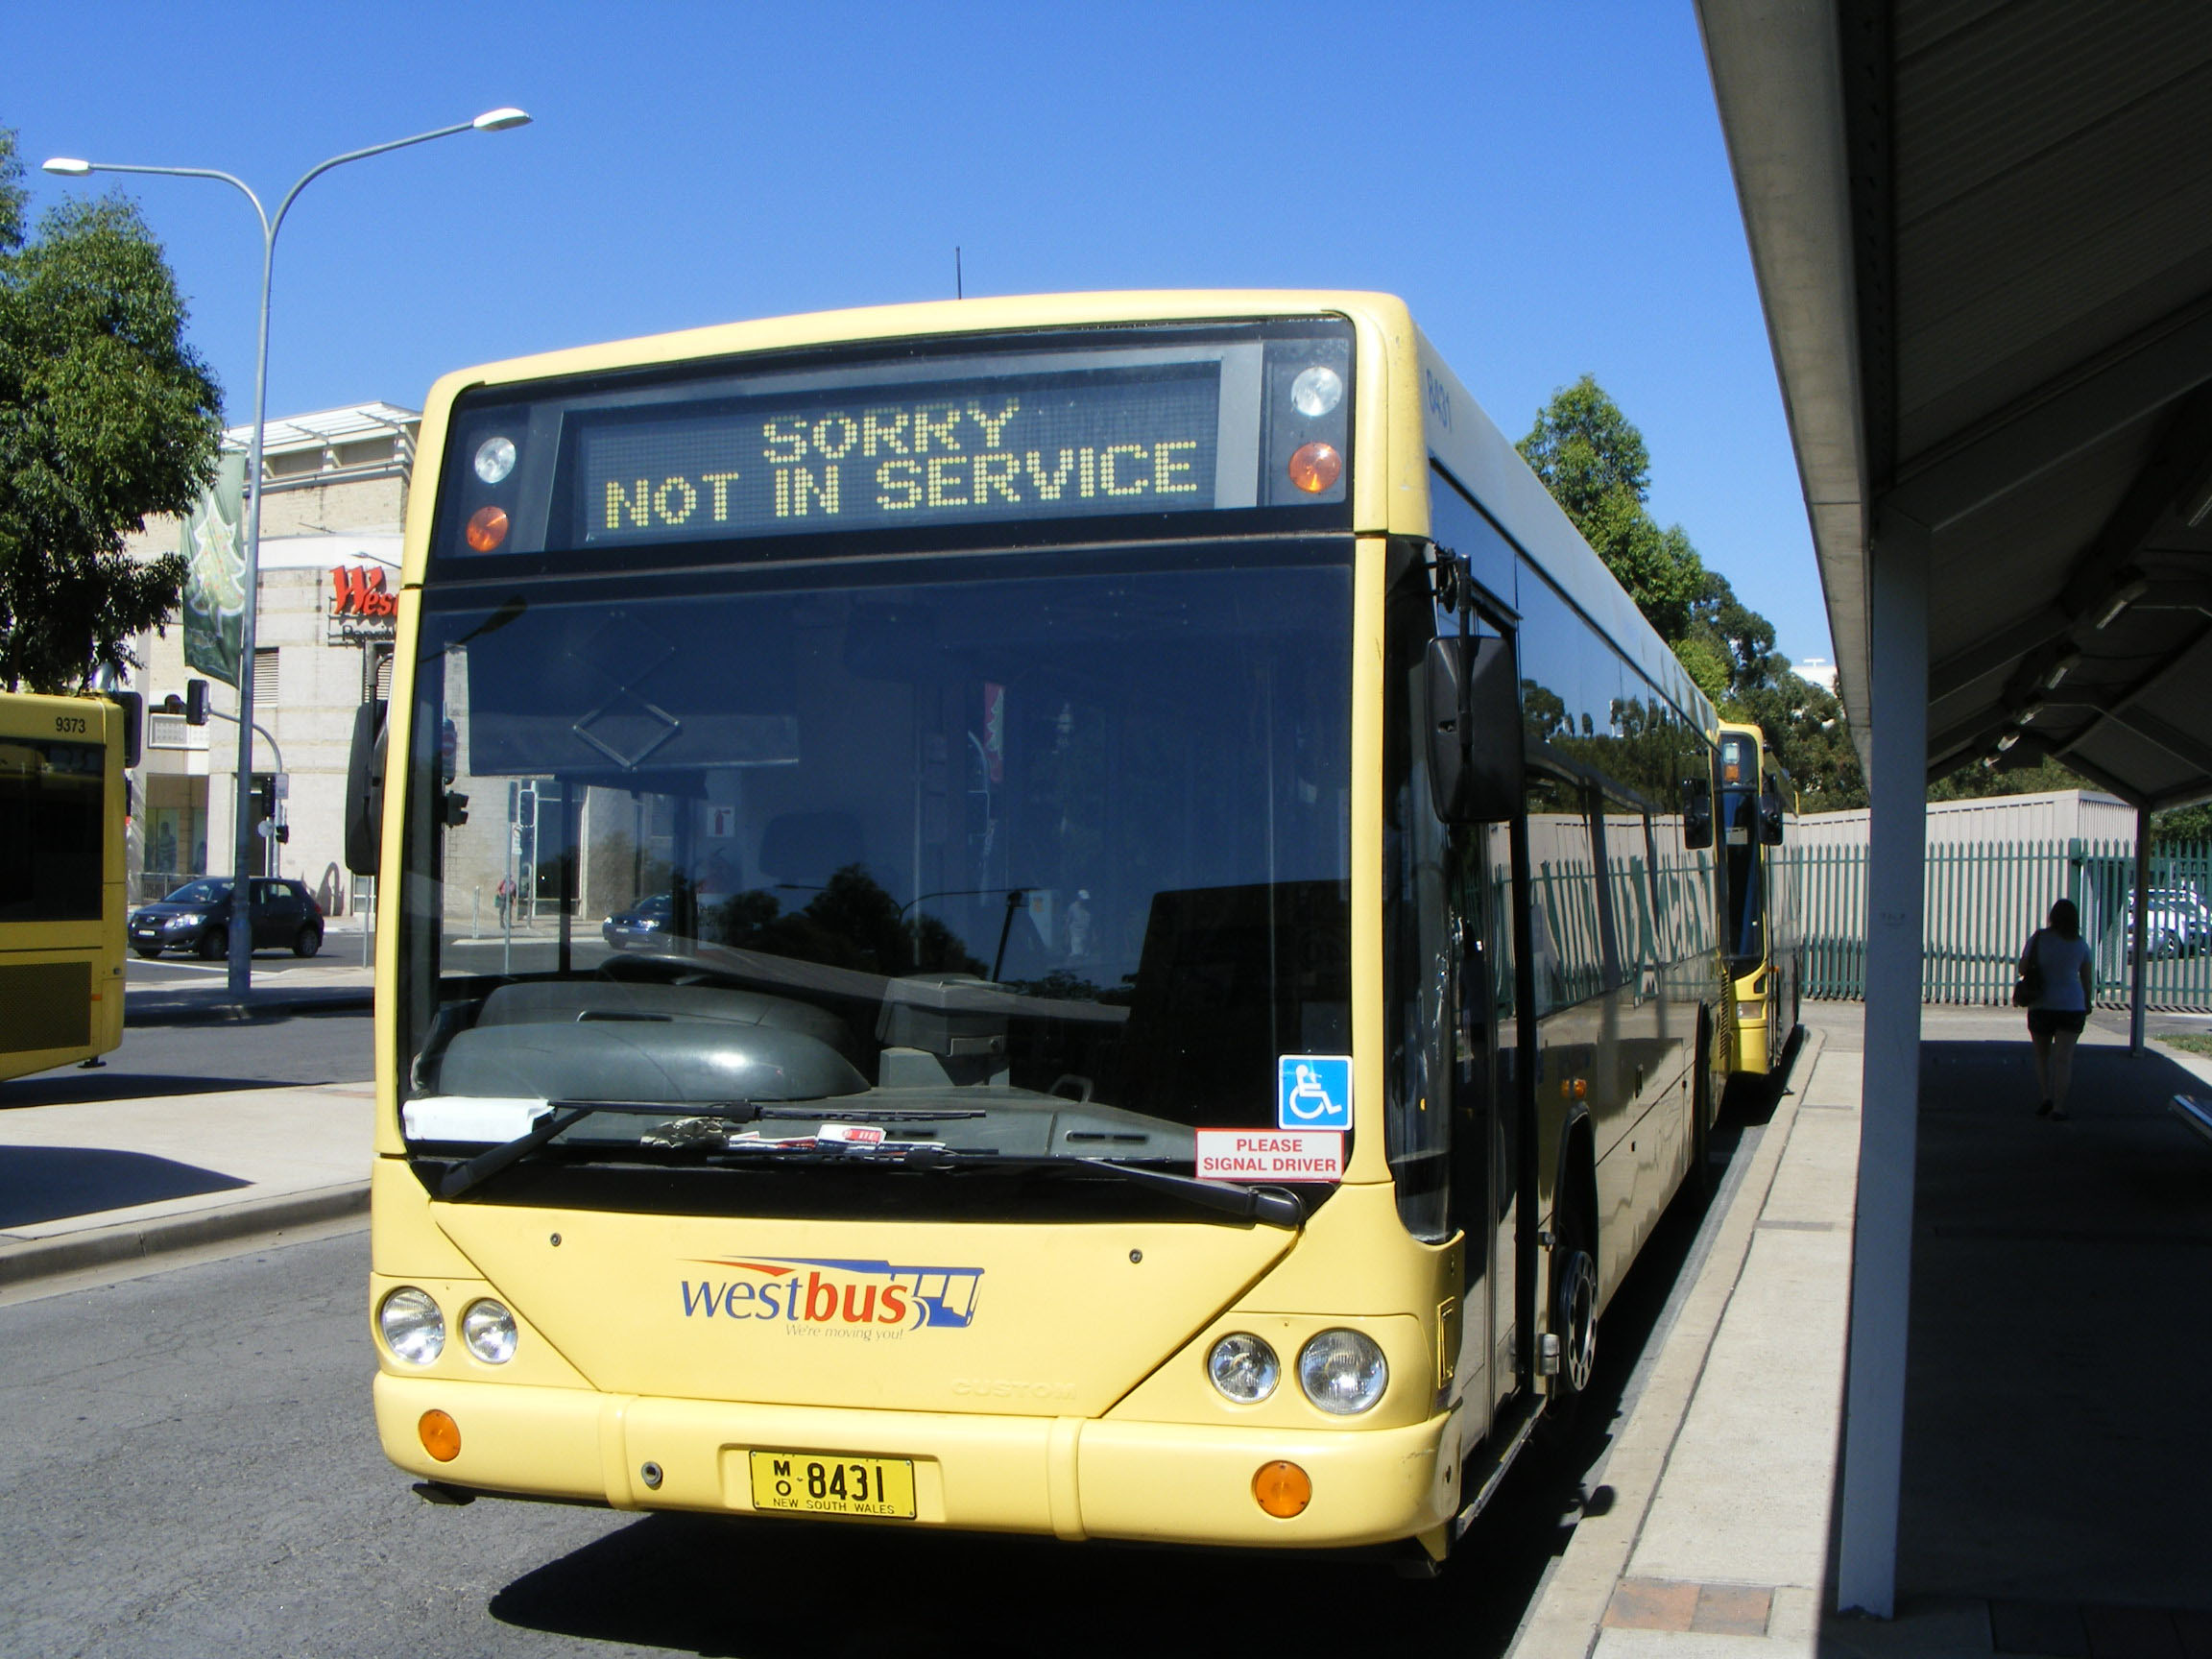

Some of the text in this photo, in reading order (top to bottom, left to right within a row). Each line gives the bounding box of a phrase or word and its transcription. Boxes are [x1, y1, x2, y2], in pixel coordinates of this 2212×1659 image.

[1426, 369, 1452, 434] 8431
[763, 397, 1020, 464] SORRY
[606, 440, 1198, 529] NOT IN SERVICE
[56, 716, 85, 733] 9373
[1237, 1139, 1303, 1152] PLEASE
[1203, 1157, 1336, 1171] SIGNAL DRIVER
[785, 1324, 903, 1341] We're moving you!
[951, 1378, 1076, 1400] CUSTOM
[807, 1462, 884, 1503] 8431
[773, 1498, 895, 1515] NEW SOUTH WALES
